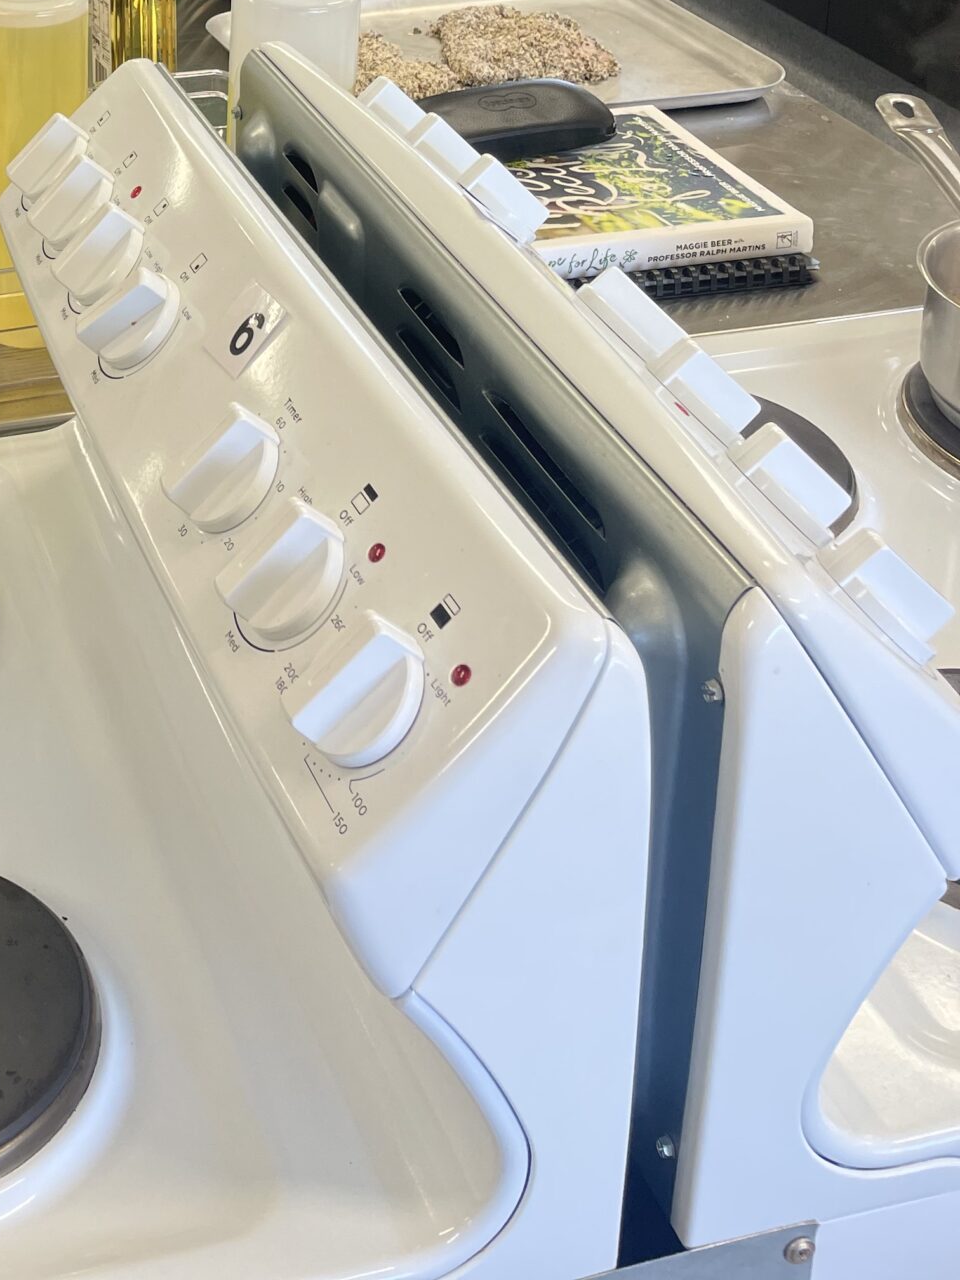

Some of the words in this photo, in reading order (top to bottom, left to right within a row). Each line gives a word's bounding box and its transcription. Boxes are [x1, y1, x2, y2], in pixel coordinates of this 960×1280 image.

[647, 251, 697, 263] PROFESSOR
[699, 248, 727, 257] RALPH
[729, 243, 766, 253] MARTINS
[675, 241, 708, 252] MAGGIE
[711, 239, 732, 248] BEER
[568, 253, 588, 273] for
[586, 248, 618, 271] Life
[180, 271, 190, 283] Off
[181, 306, 192, 321] Low
[229, 312, 265, 356] 6
[283, 397, 303, 424] Timer
[275, 416, 287, 430] 60
[275, 480, 285, 493] 10
[339, 509, 355, 527] Off
[178, 524, 188, 537] 30
[223, 537, 235, 552] 20
[349, 563, 365, 586] Low
[225, 630, 240, 653] Med
[417, 622, 434, 643] Off
[430, 678, 452, 707] Light
[351, 792, 367, 816] 100
[333, 812, 348, 835] 150
